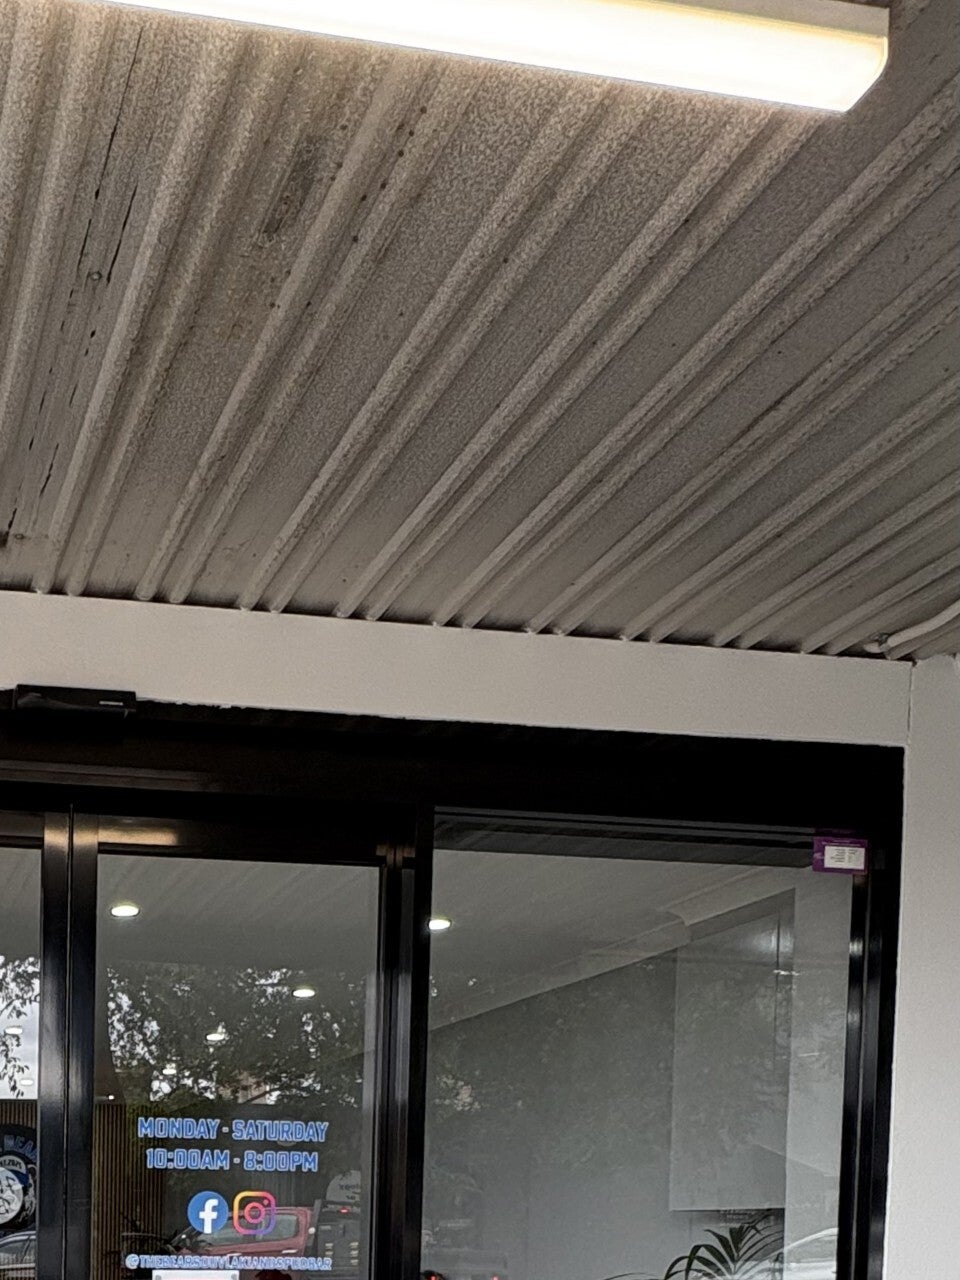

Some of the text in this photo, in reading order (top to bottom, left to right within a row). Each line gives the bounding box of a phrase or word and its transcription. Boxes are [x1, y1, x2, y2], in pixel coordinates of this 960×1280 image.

[137, 1117, 221, 1140] MONDAY
[232, 1120, 330, 1142] SATURDAY
[146, 1148, 230, 1170] 10:00AM
[243, 1150, 318, 1172] 8:00PM
